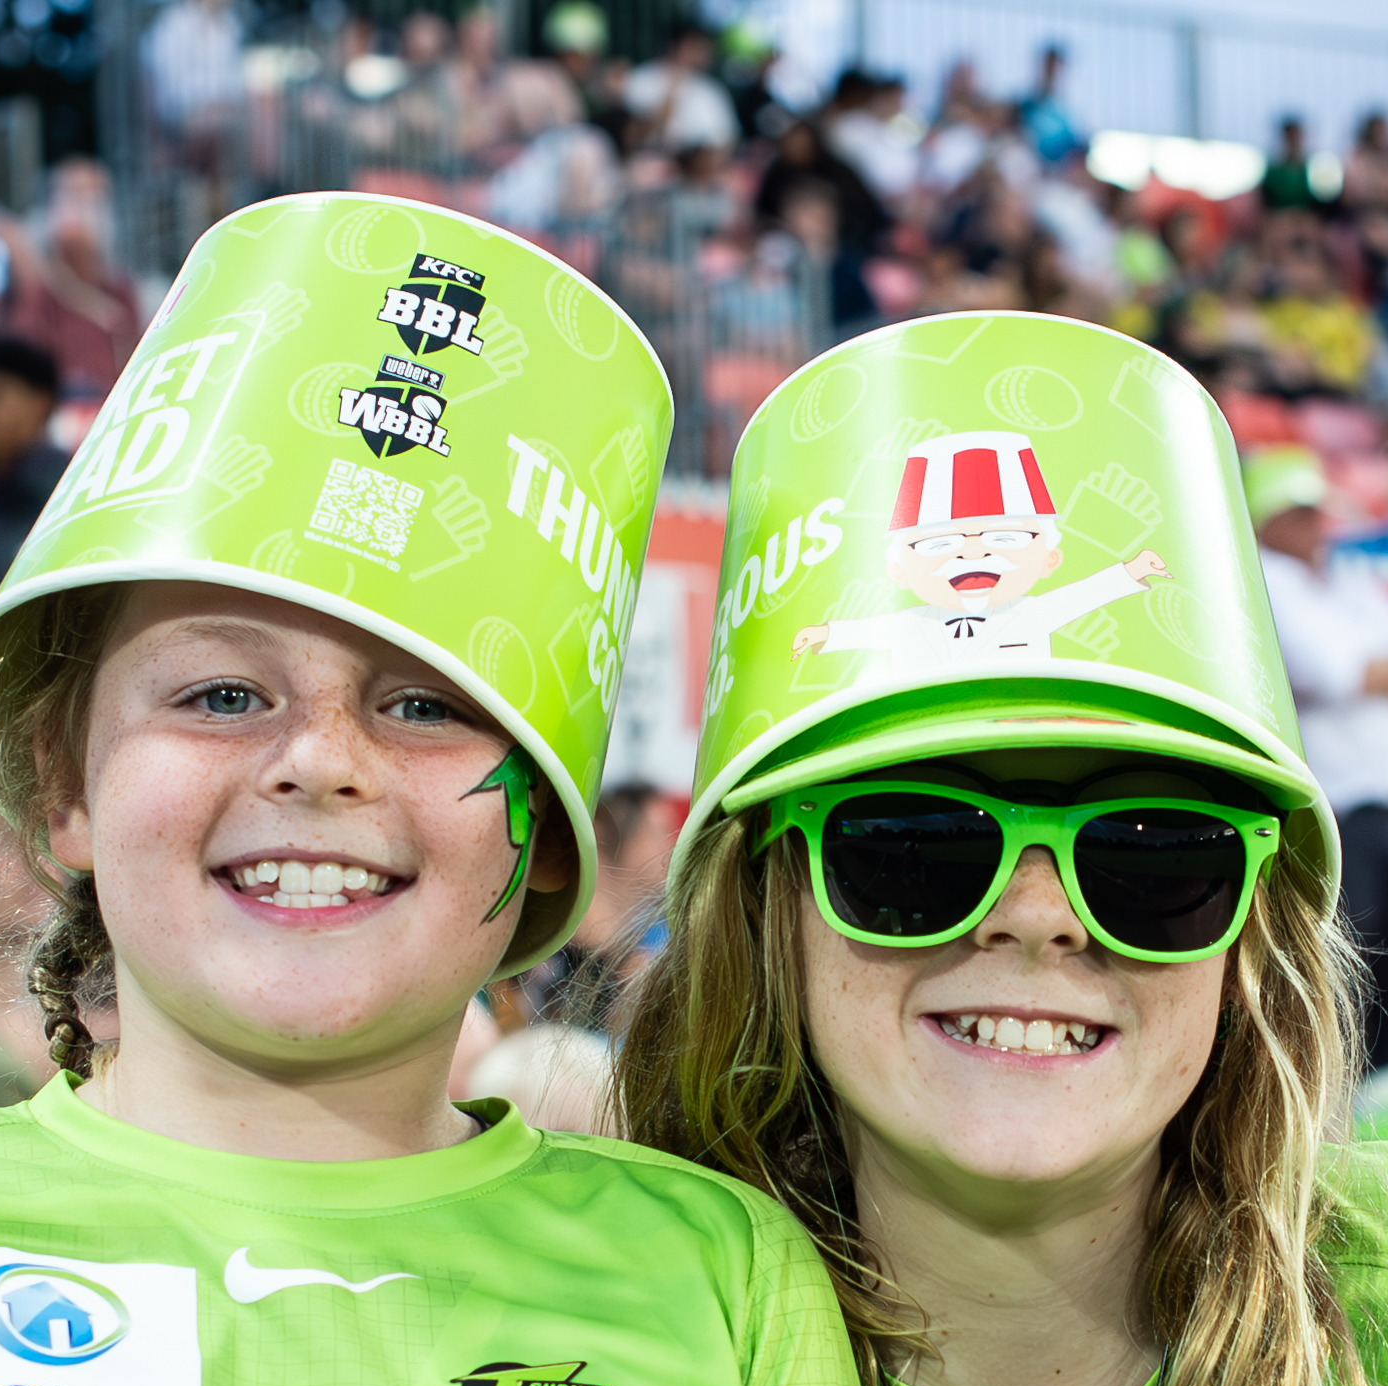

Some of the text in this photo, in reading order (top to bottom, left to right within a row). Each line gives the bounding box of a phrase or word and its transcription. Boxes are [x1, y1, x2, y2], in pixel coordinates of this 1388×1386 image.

[418, 256, 474, 285] KFC
[377, 288, 485, 356] BBL
[385, 357, 428, 383] weber
[338, 387, 452, 458] WBBL
[506, 432, 637, 665] THUND
[711, 497, 846, 668] ROUS
